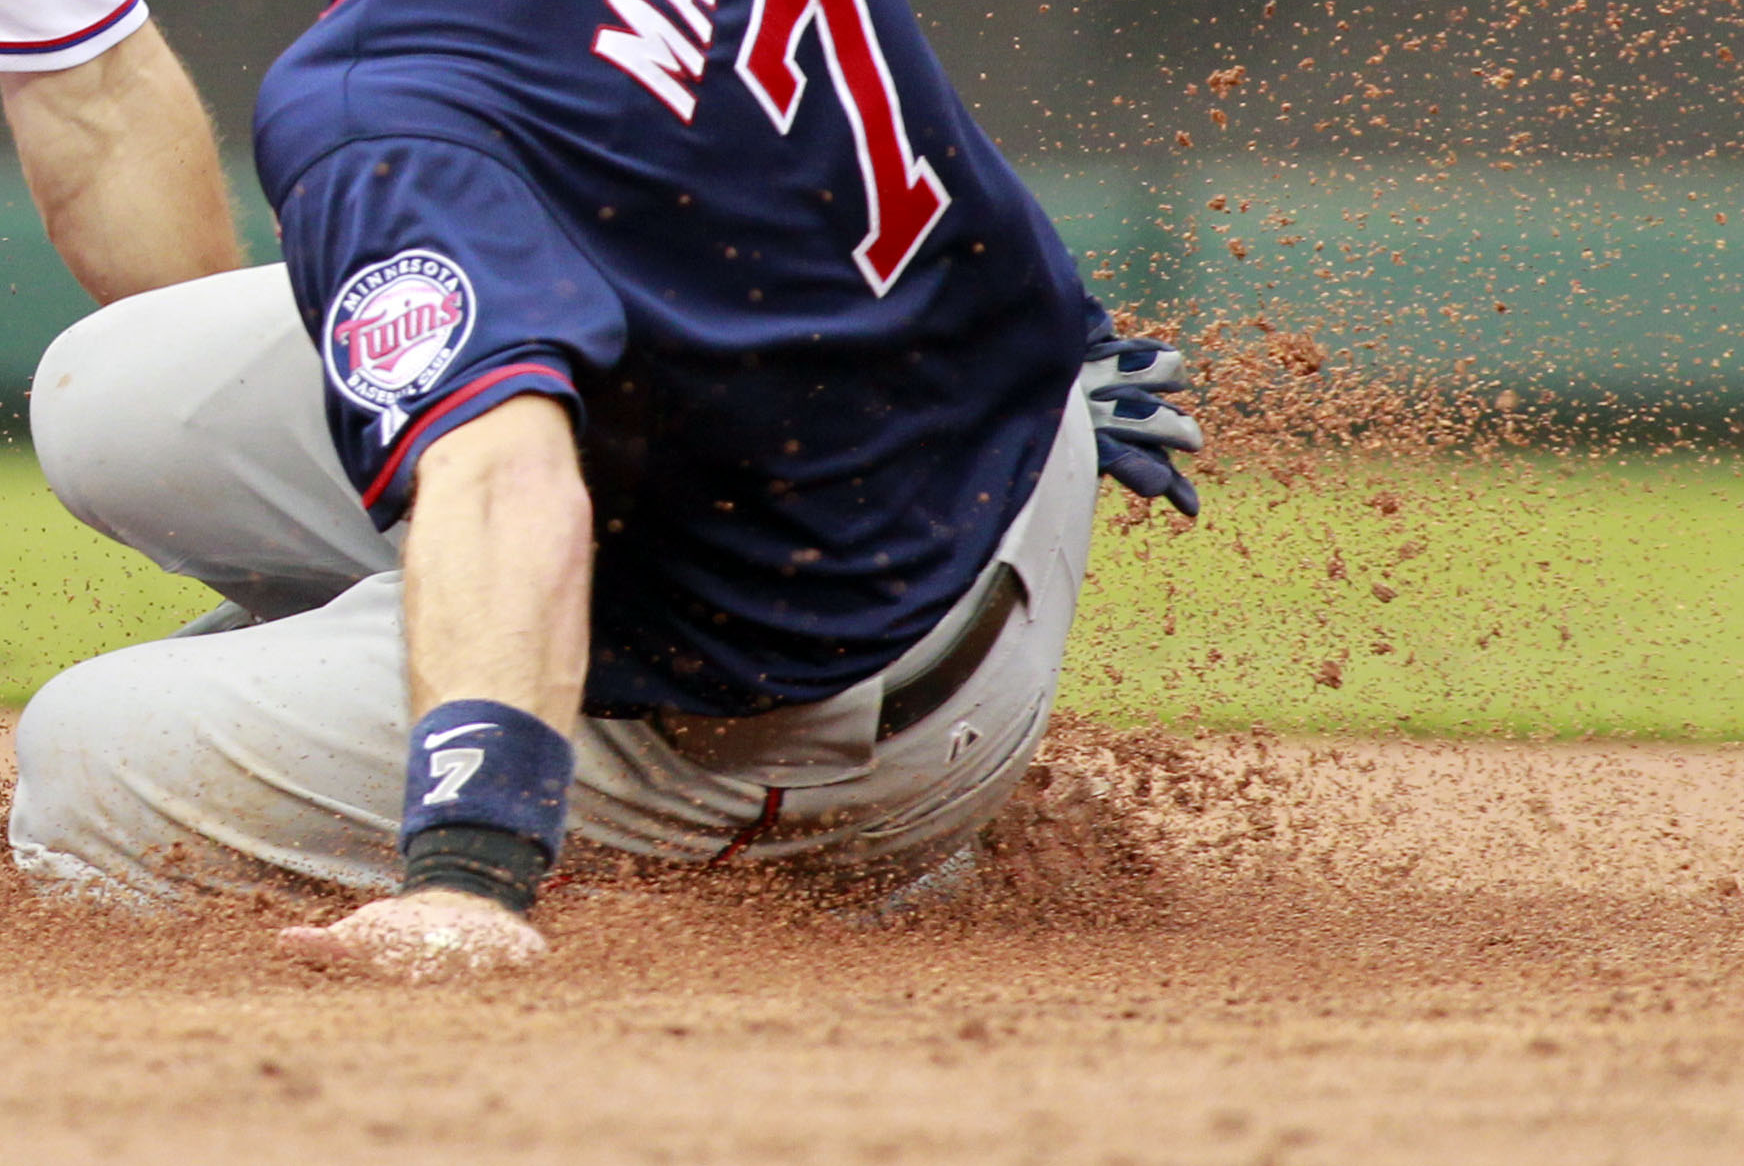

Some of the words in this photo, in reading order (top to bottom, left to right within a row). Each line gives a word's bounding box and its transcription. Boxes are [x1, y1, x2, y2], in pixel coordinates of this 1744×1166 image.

[342, 259, 460, 313] MINNESOTA
[334, 291, 462, 371] Twins
[423, 748, 485, 806] 7
